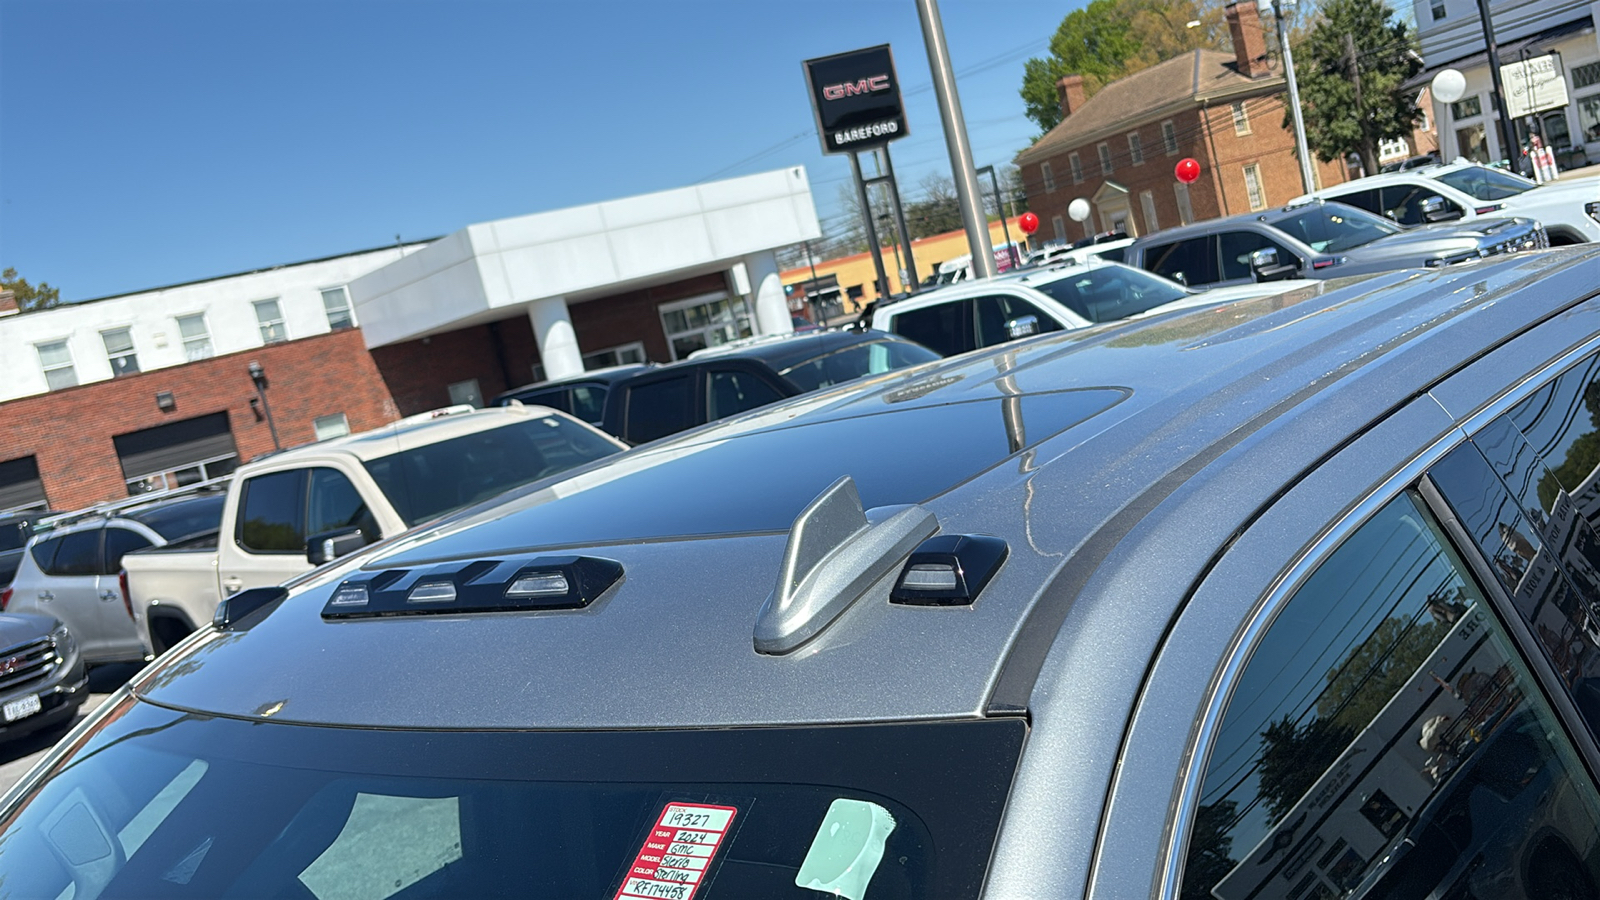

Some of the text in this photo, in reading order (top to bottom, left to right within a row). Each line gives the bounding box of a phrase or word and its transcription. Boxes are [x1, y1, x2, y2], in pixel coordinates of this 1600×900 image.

[823, 74, 890, 101] GMC
[834, 121, 898, 143] BAREFORD
[669, 813, 710, 827] 19327
[678, 831, 708, 843] 2024
[647, 842, 666, 850] MAKE
[633, 867, 654, 875] COLOR
